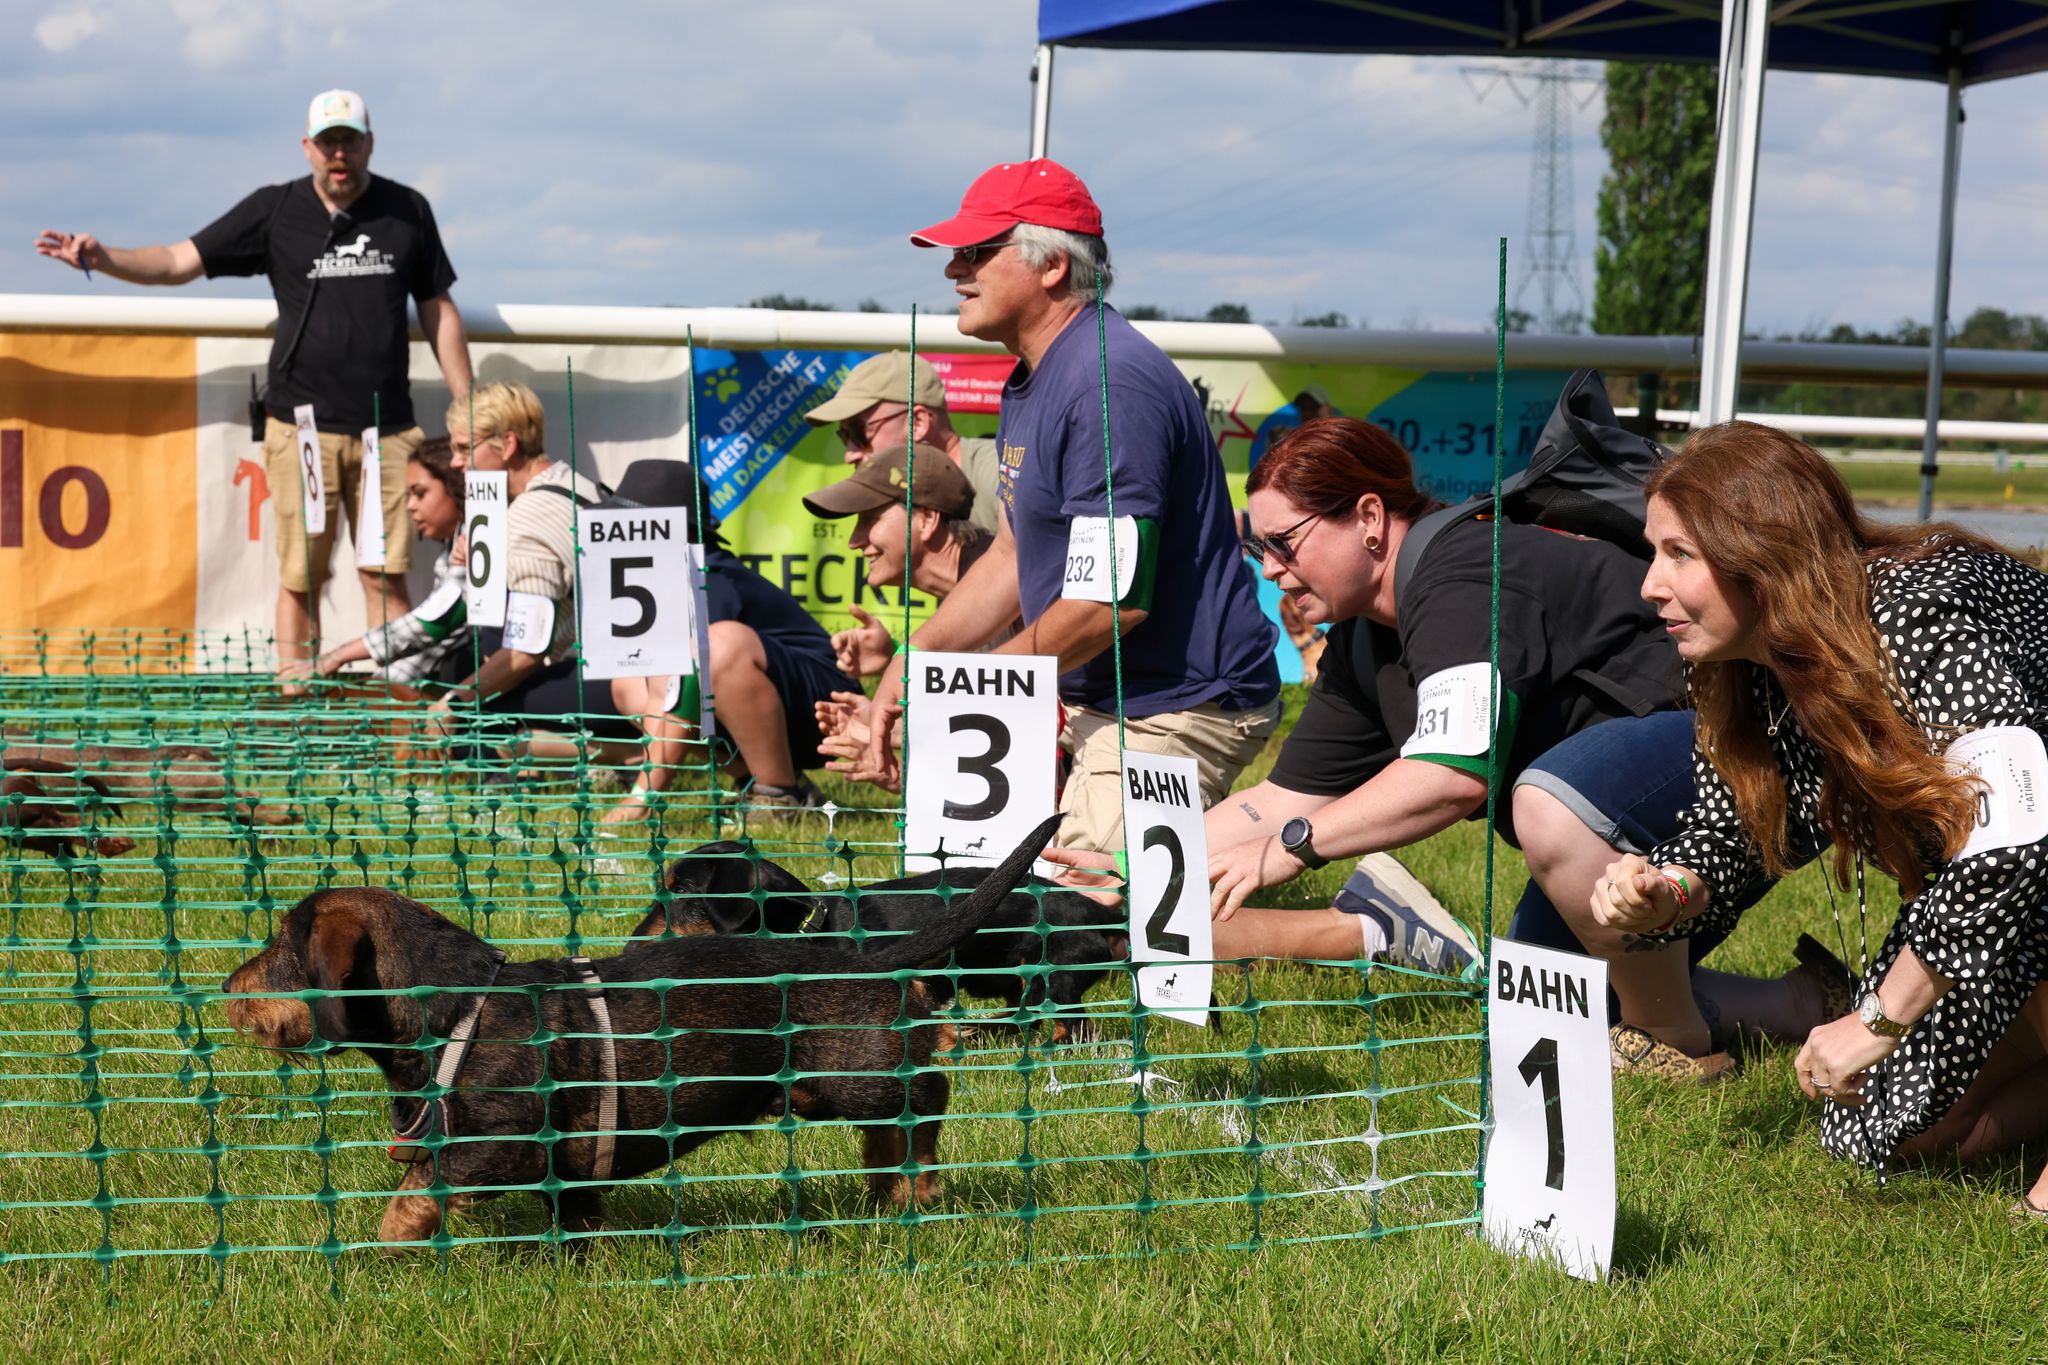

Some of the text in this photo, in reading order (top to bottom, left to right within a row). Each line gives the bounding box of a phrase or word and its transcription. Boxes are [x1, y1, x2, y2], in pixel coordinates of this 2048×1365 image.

[701, 350, 803, 453] 2. DEUTSCHE
[704, 356, 828, 482] MEISTERSCHAFT
[709, 363, 850, 510] IM DACKELRENNEN
[303, 442, 318, 502] 8
[467, 481, 498, 500] AHN
[468, 514, 491, 588] 6
[590, 519, 671, 543] BAHN
[611, 556, 657, 638] 5
[1065, 555, 1095, 583] 232
[925, 666, 1035, 697] BAHN
[1479, 696, 1489, 732] PLATINUM
[942, 713, 1012, 822] 3
[1127, 767, 1191, 809] BAHN
[2022, 769, 2035, 812] PLATINUM
[1143, 825, 1190, 957] 2
[1498, 959, 1589, 1019] BAHN
[1518, 1037, 1565, 1191] 1
